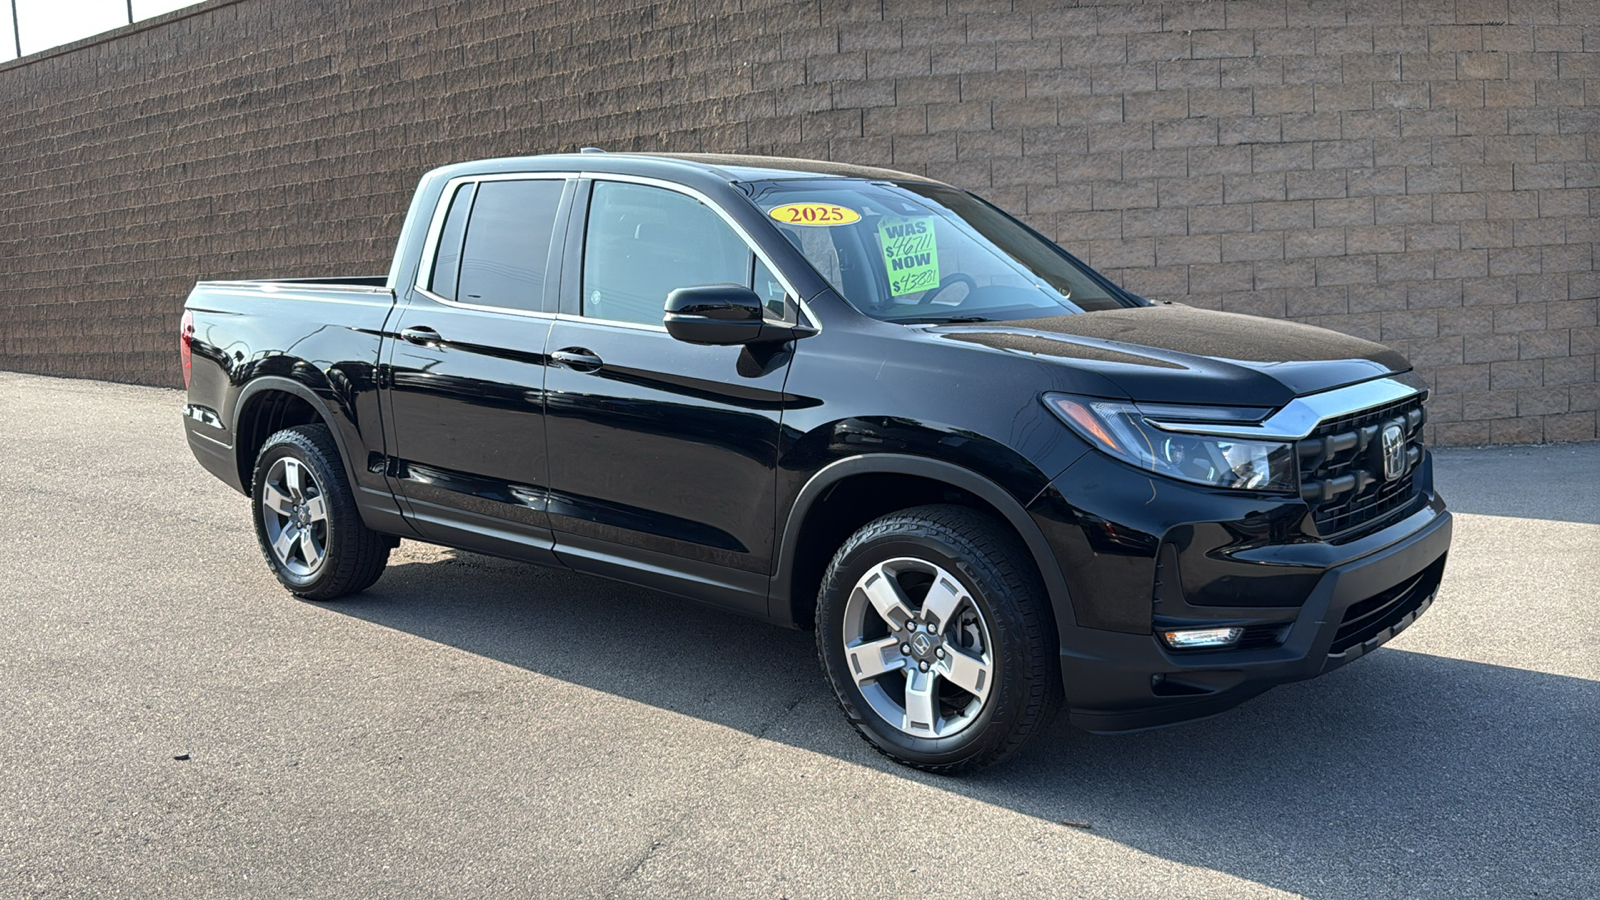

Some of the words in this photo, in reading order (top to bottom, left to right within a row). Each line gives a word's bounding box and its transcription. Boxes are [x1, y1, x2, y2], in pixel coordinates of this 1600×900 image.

[787, 207, 844, 222] 2025
[885, 221, 927, 239] WAS
[892, 252, 931, 271] NOW
